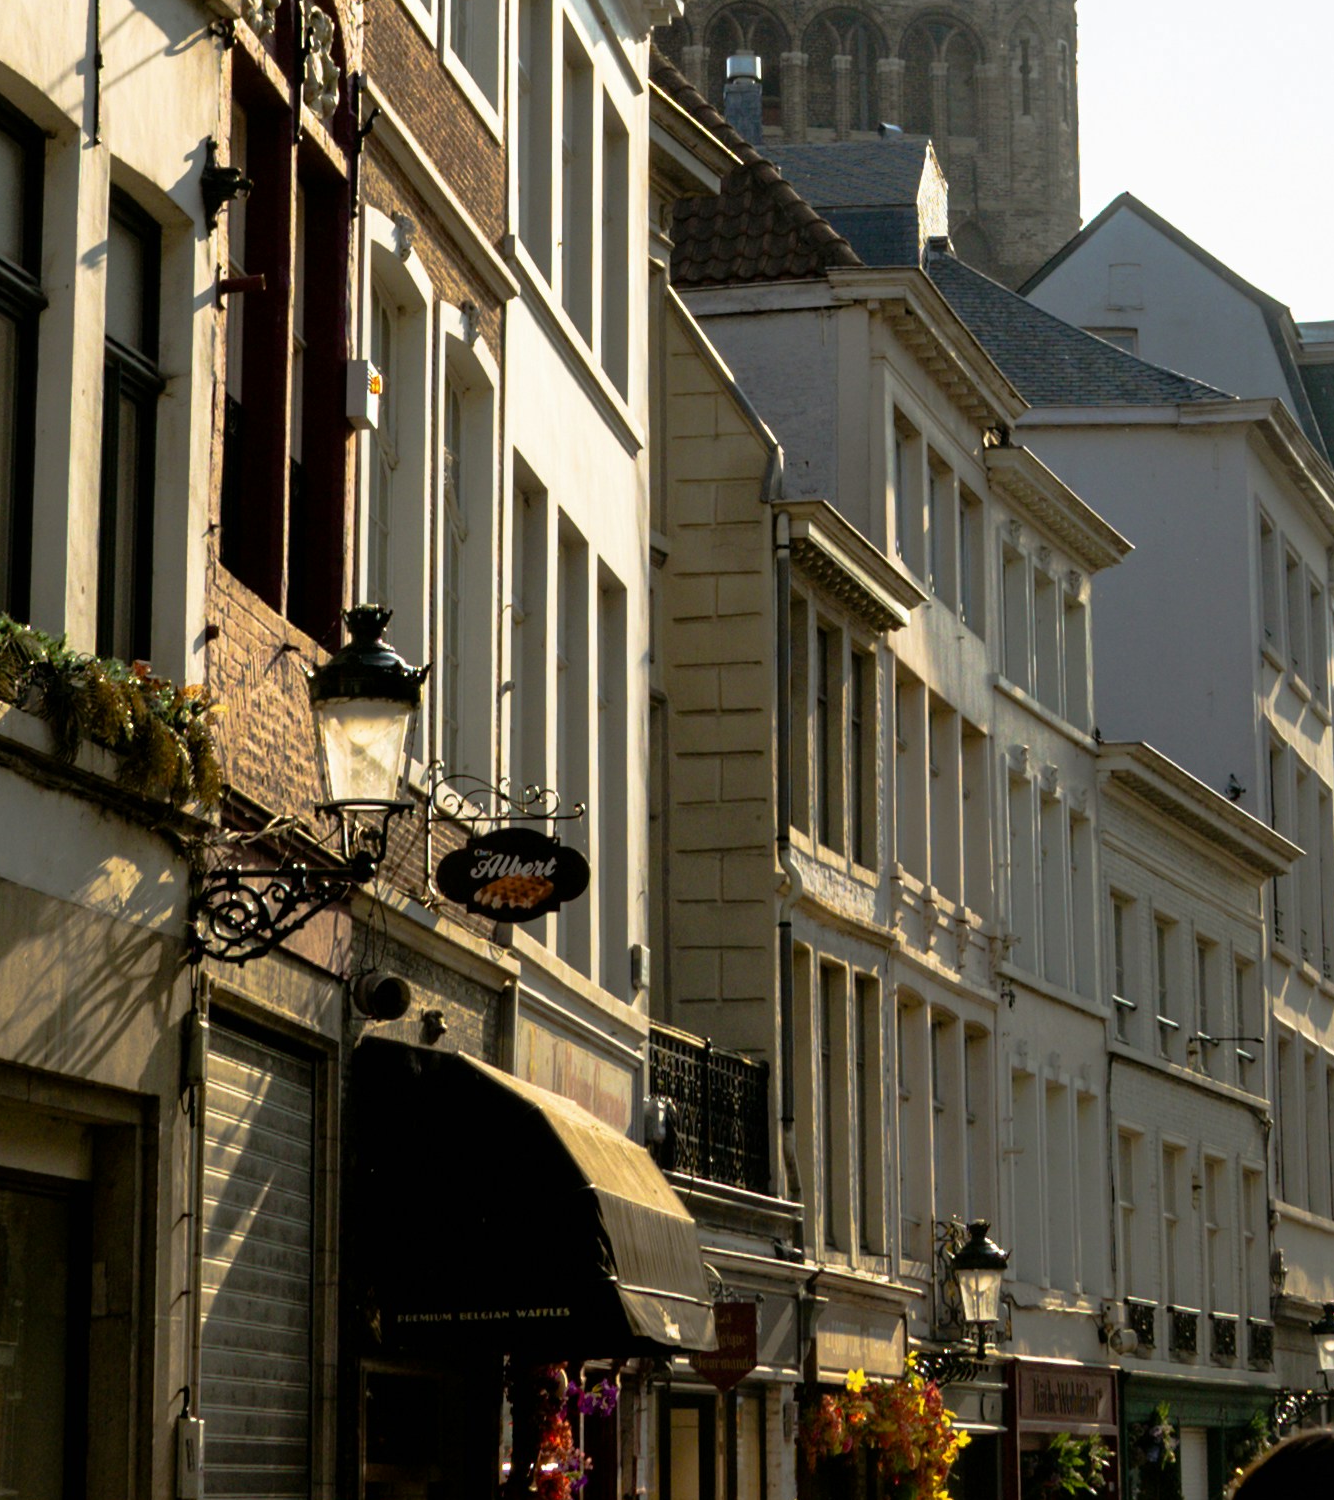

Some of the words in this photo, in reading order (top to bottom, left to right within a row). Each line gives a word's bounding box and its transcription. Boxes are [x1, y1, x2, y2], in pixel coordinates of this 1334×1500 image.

[470, 853, 558, 879] Albert
[396, 1312, 453, 1324] PREMIUM
[458, 1310, 511, 1322] BELGIAN
[515, 1306, 571, 1319] WAFFLES
